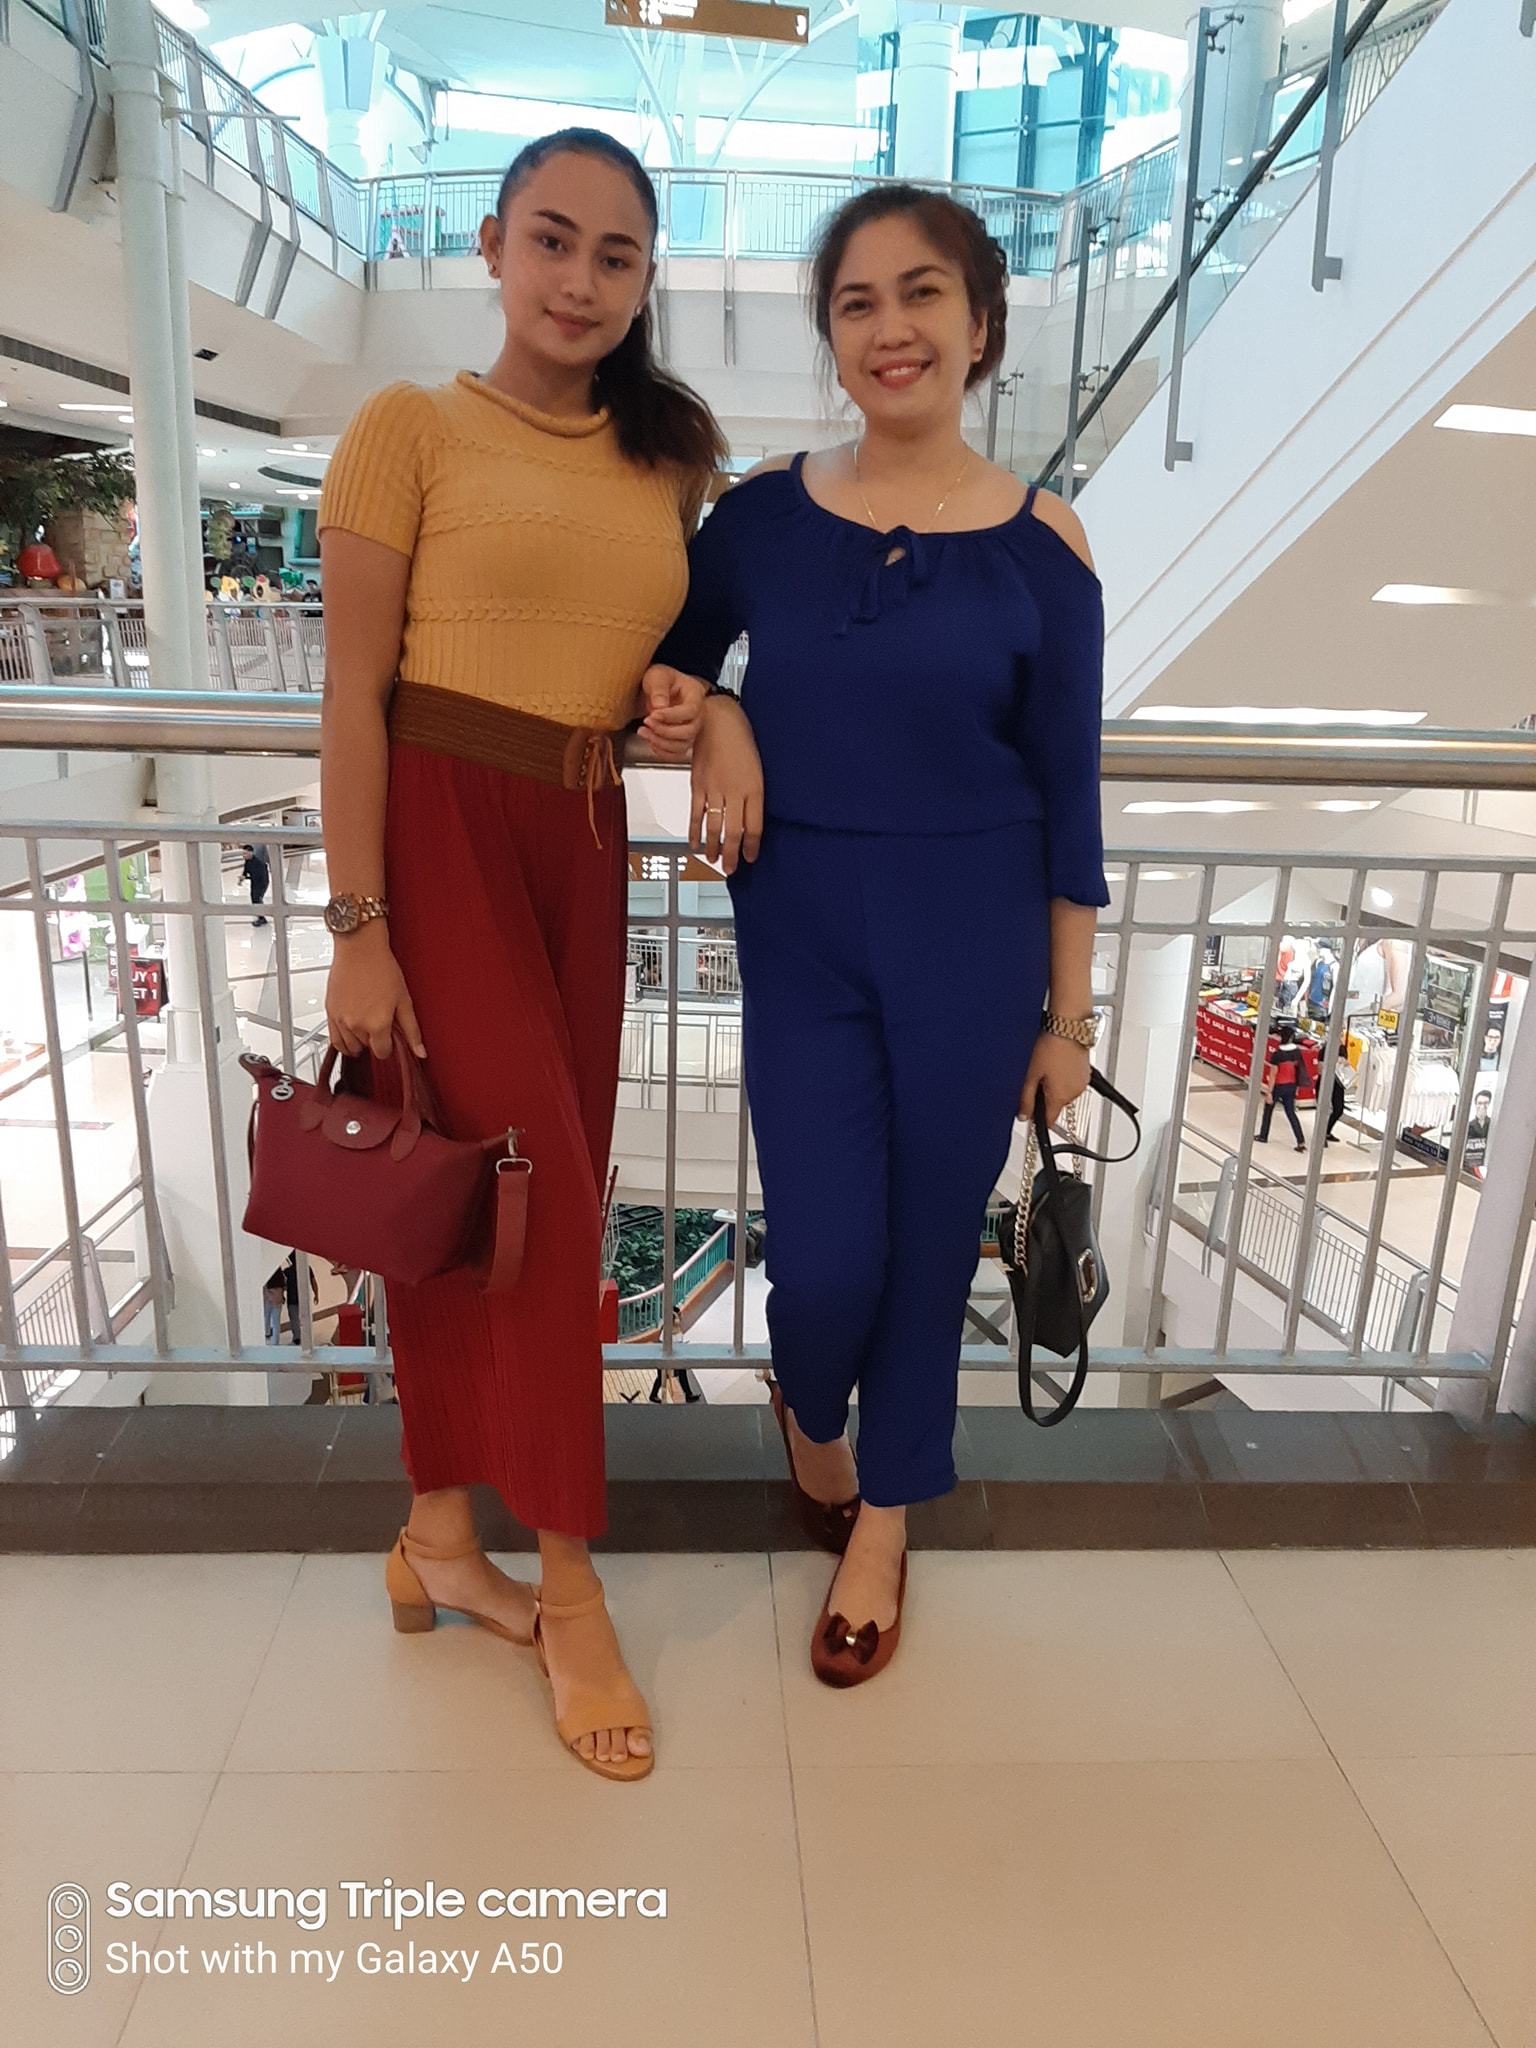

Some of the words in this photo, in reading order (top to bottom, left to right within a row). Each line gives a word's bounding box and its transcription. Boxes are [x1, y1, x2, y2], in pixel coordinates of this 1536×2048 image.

[151, 972, 158, 983] 1
[133, 987, 147, 999] ET
[151, 989, 158, 1000] 1
